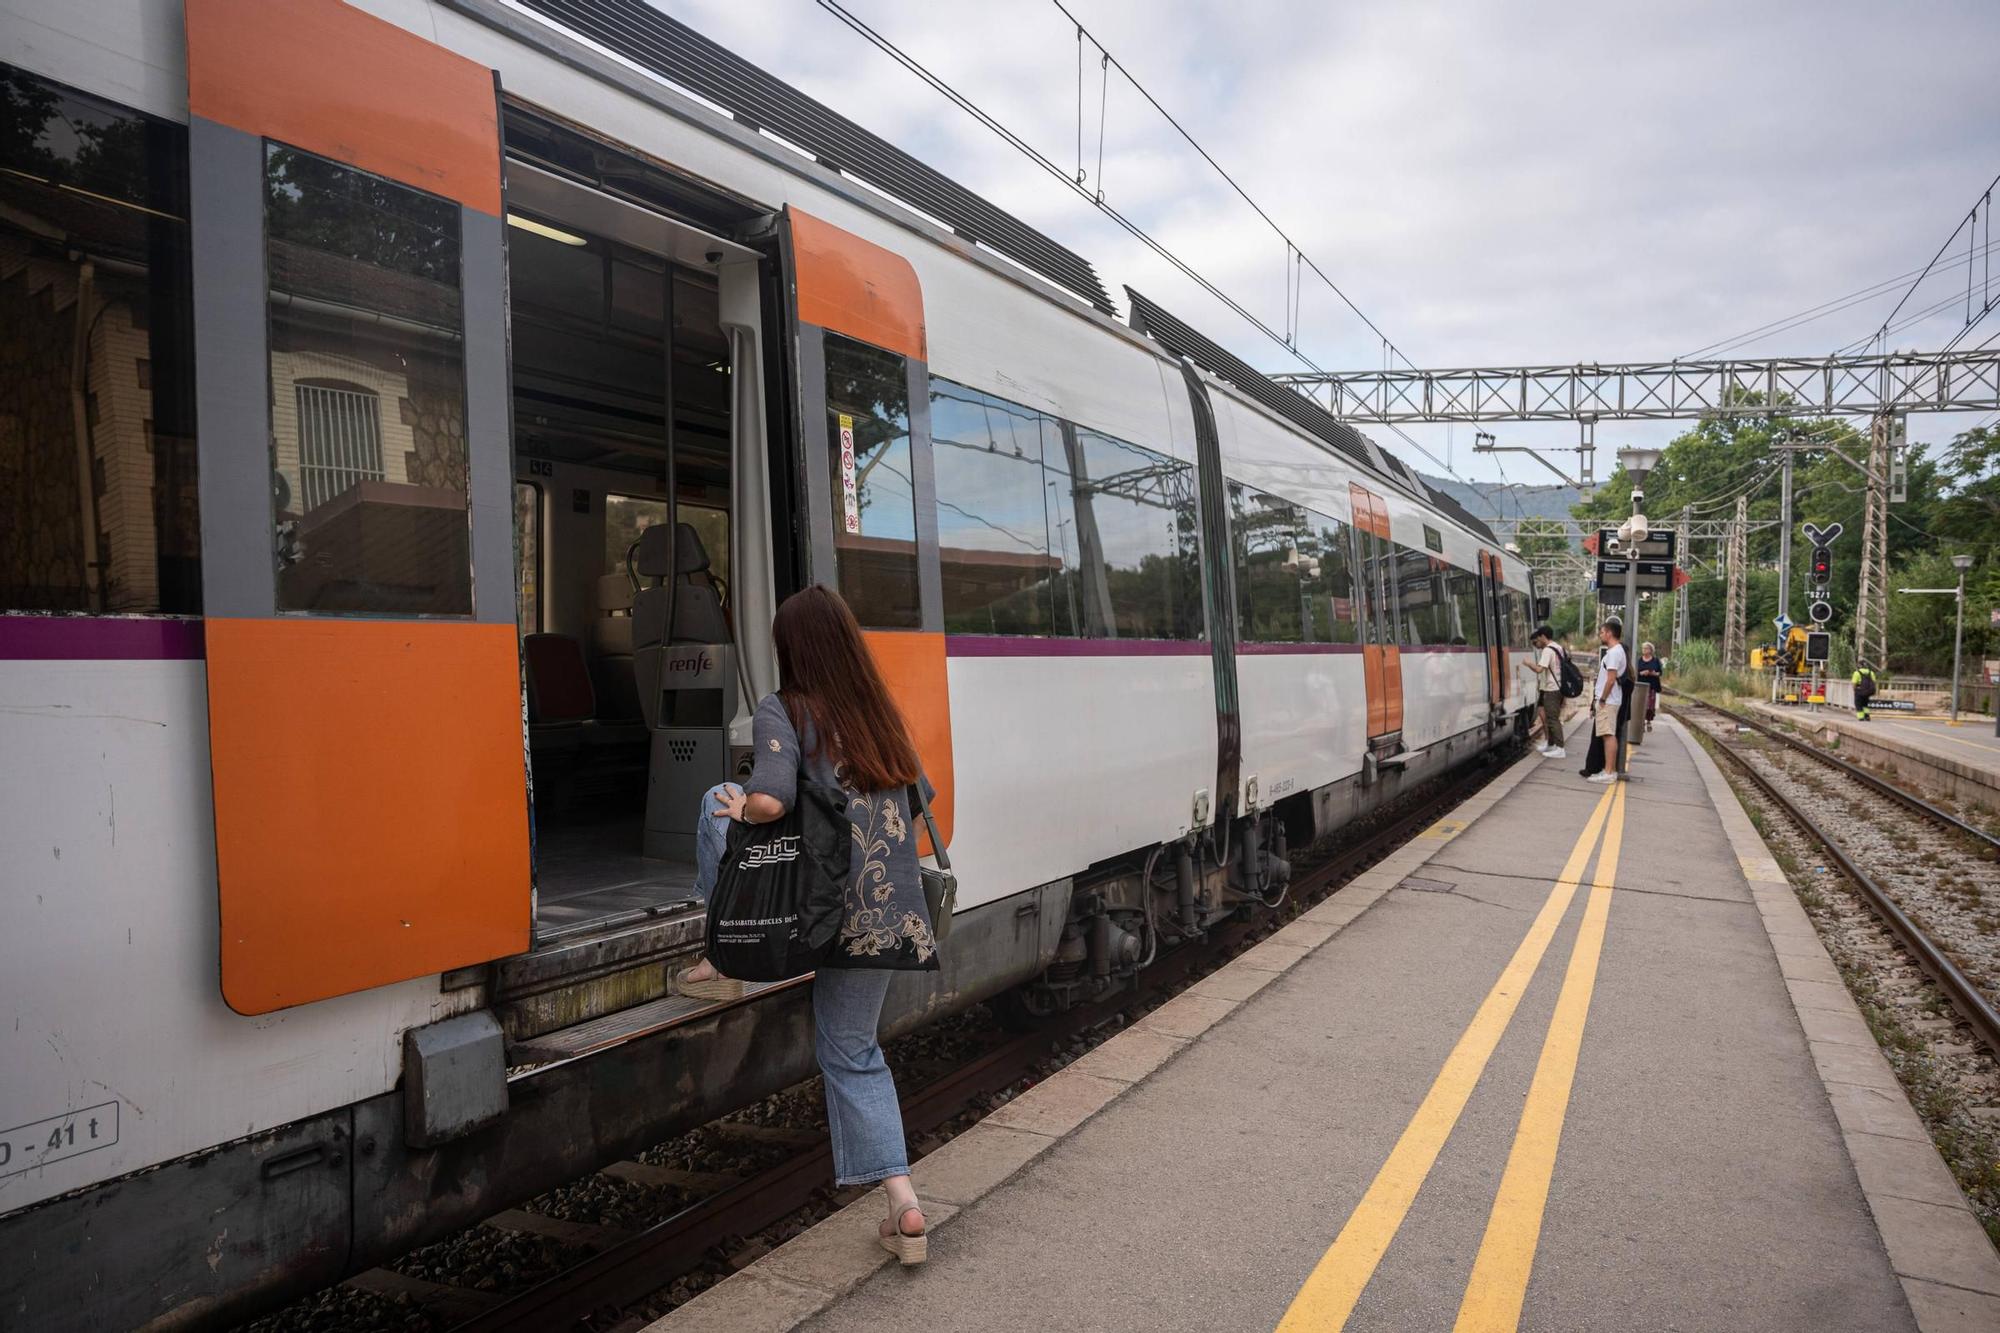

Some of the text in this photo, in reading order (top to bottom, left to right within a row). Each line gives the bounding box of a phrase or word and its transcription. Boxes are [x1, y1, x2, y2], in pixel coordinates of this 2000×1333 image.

[669, 651, 713, 677] renfe
[757, 917, 783, 926] ARTICLES
[47, 1123, 75, 1150] 41
[88, 1118, 99, 1139] t
